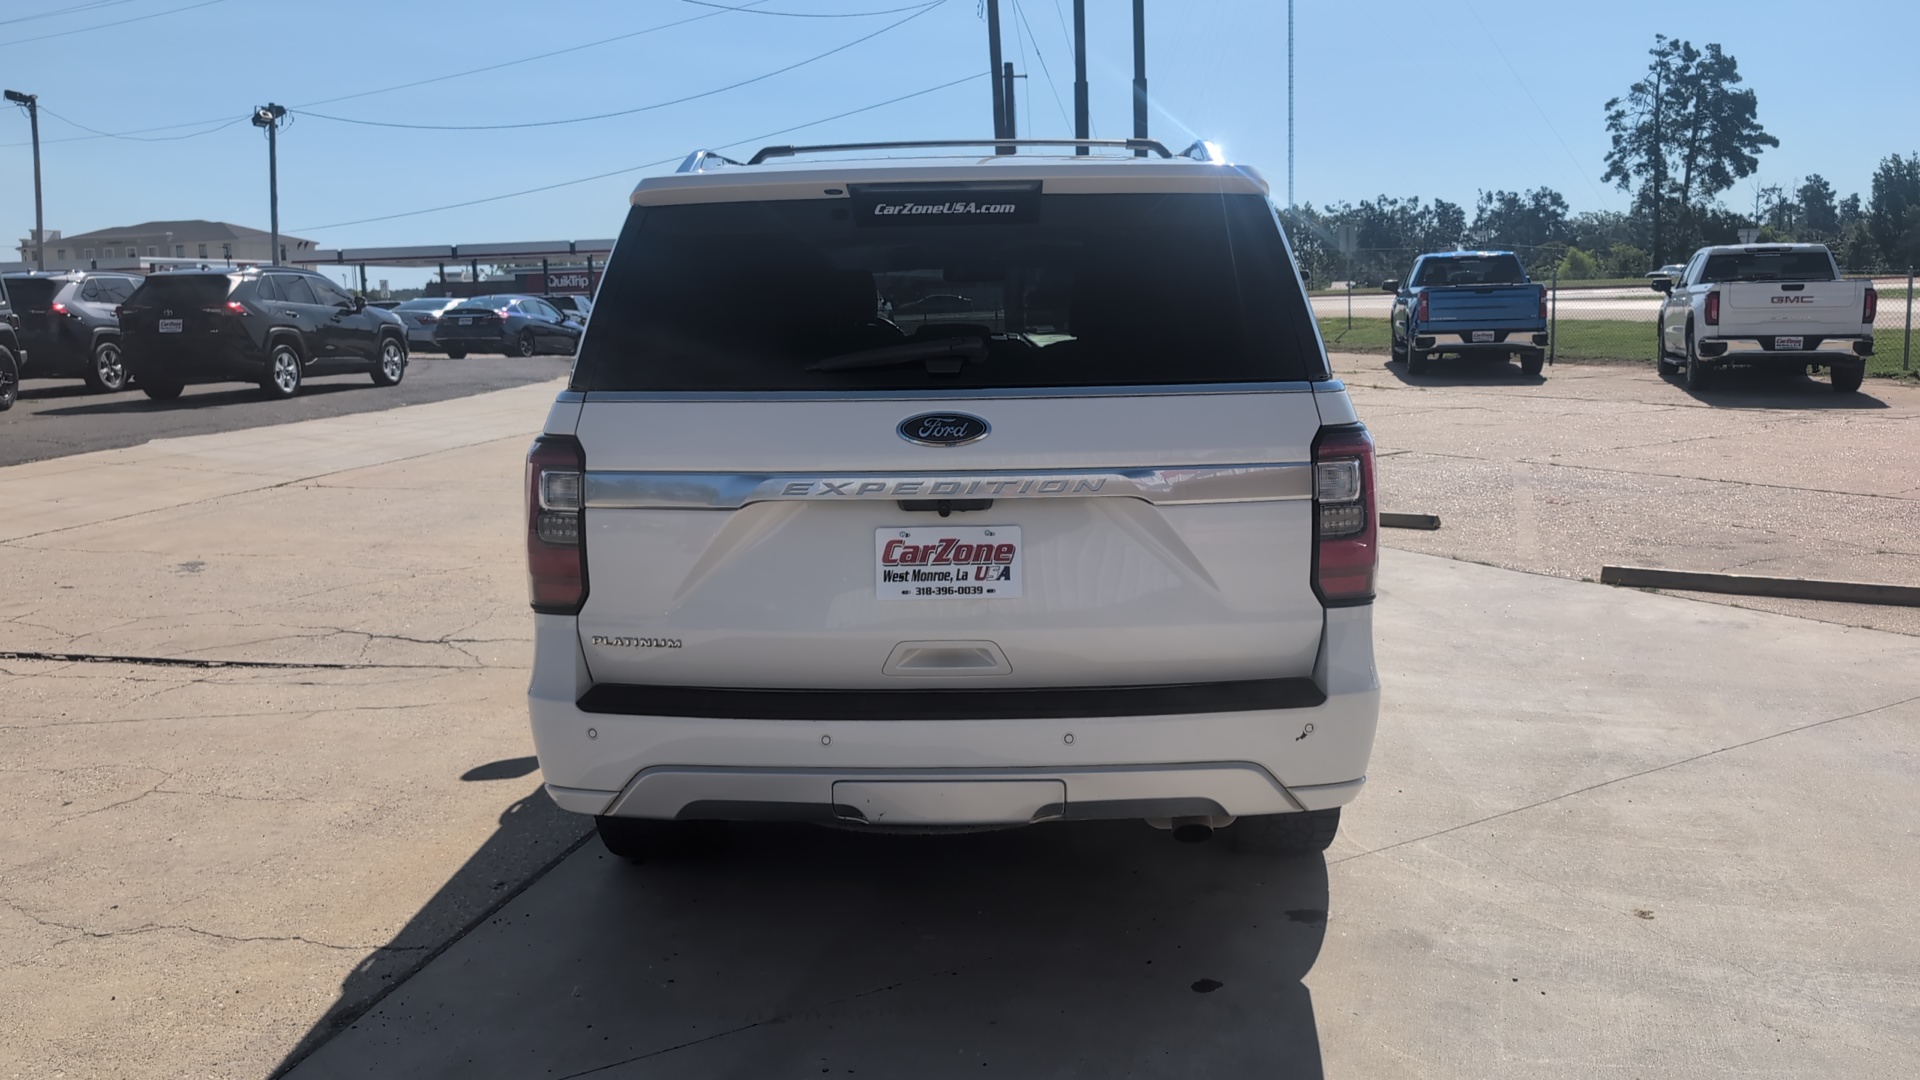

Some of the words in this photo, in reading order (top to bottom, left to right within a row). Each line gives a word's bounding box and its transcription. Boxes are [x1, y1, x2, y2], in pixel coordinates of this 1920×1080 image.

[874, 202, 1016, 215] CarZoneUSA.com
[548, 274, 589, 289] QuikTrip
[1770, 296, 1814, 304] GMC
[918, 417, 969, 438] Ford
[781, 477, 1107, 496] EXPEDITION
[881, 538, 1016, 567] CarZone
[883, 569, 909, 583] West
[911, 568, 954, 584] Monroe,
[956, 568, 969, 582] La
[974, 565, 1011, 582] USA
[915, 585, 984, 596] 318-396-0039
[591, 635, 682, 649] PLATINUM
